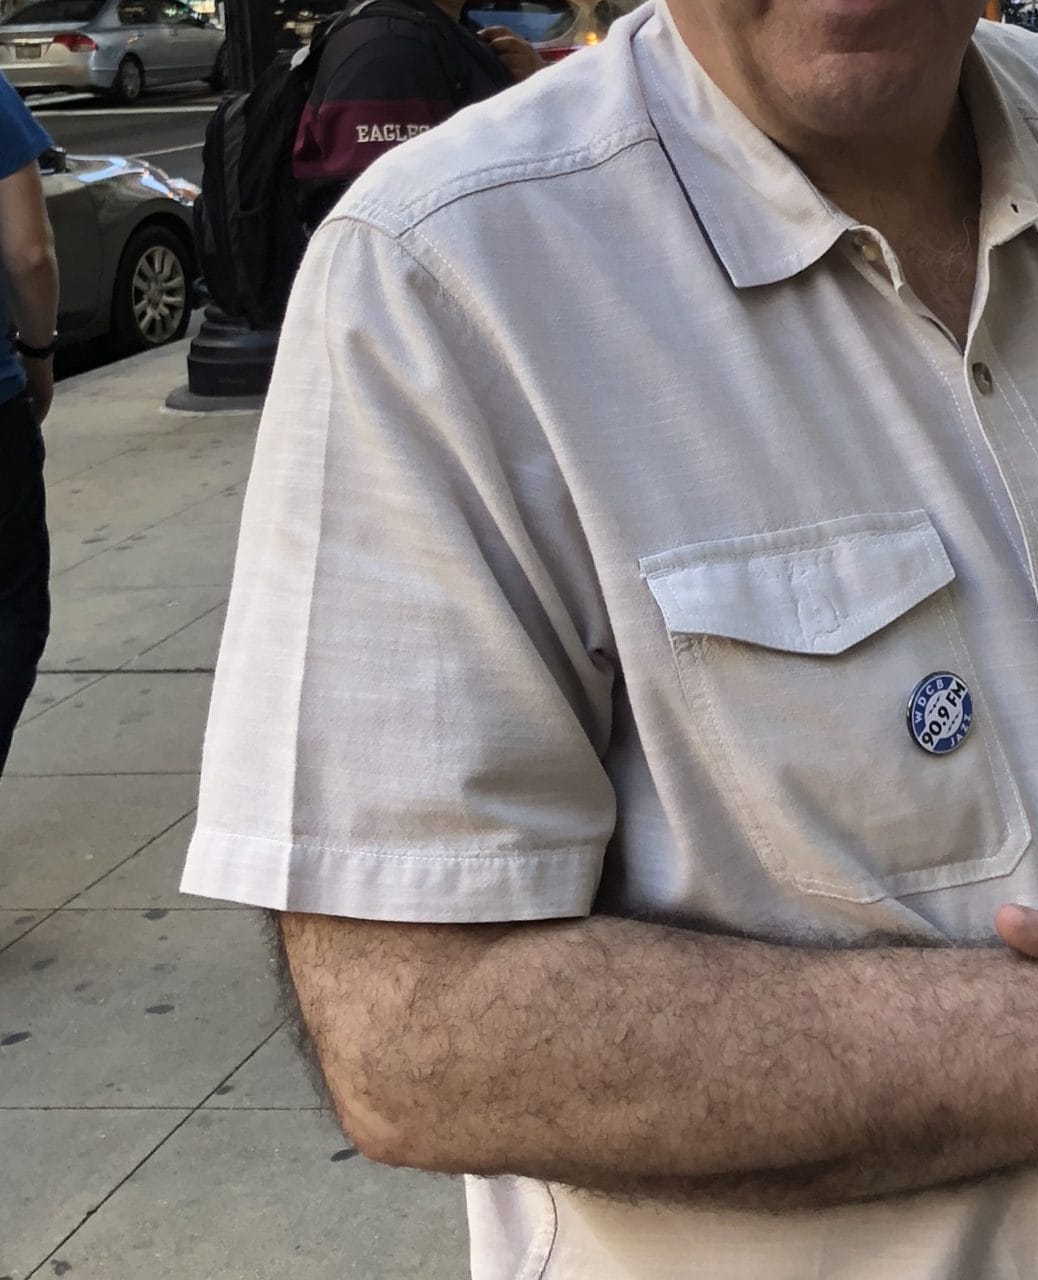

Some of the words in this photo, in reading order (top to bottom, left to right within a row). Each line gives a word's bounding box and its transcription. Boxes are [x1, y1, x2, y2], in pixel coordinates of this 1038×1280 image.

[914, 679, 944, 724] WDCB
[945, 679, 966, 707] FM
[921, 706, 950, 747] 90.9
[950, 714, 972, 747] JAZZ
